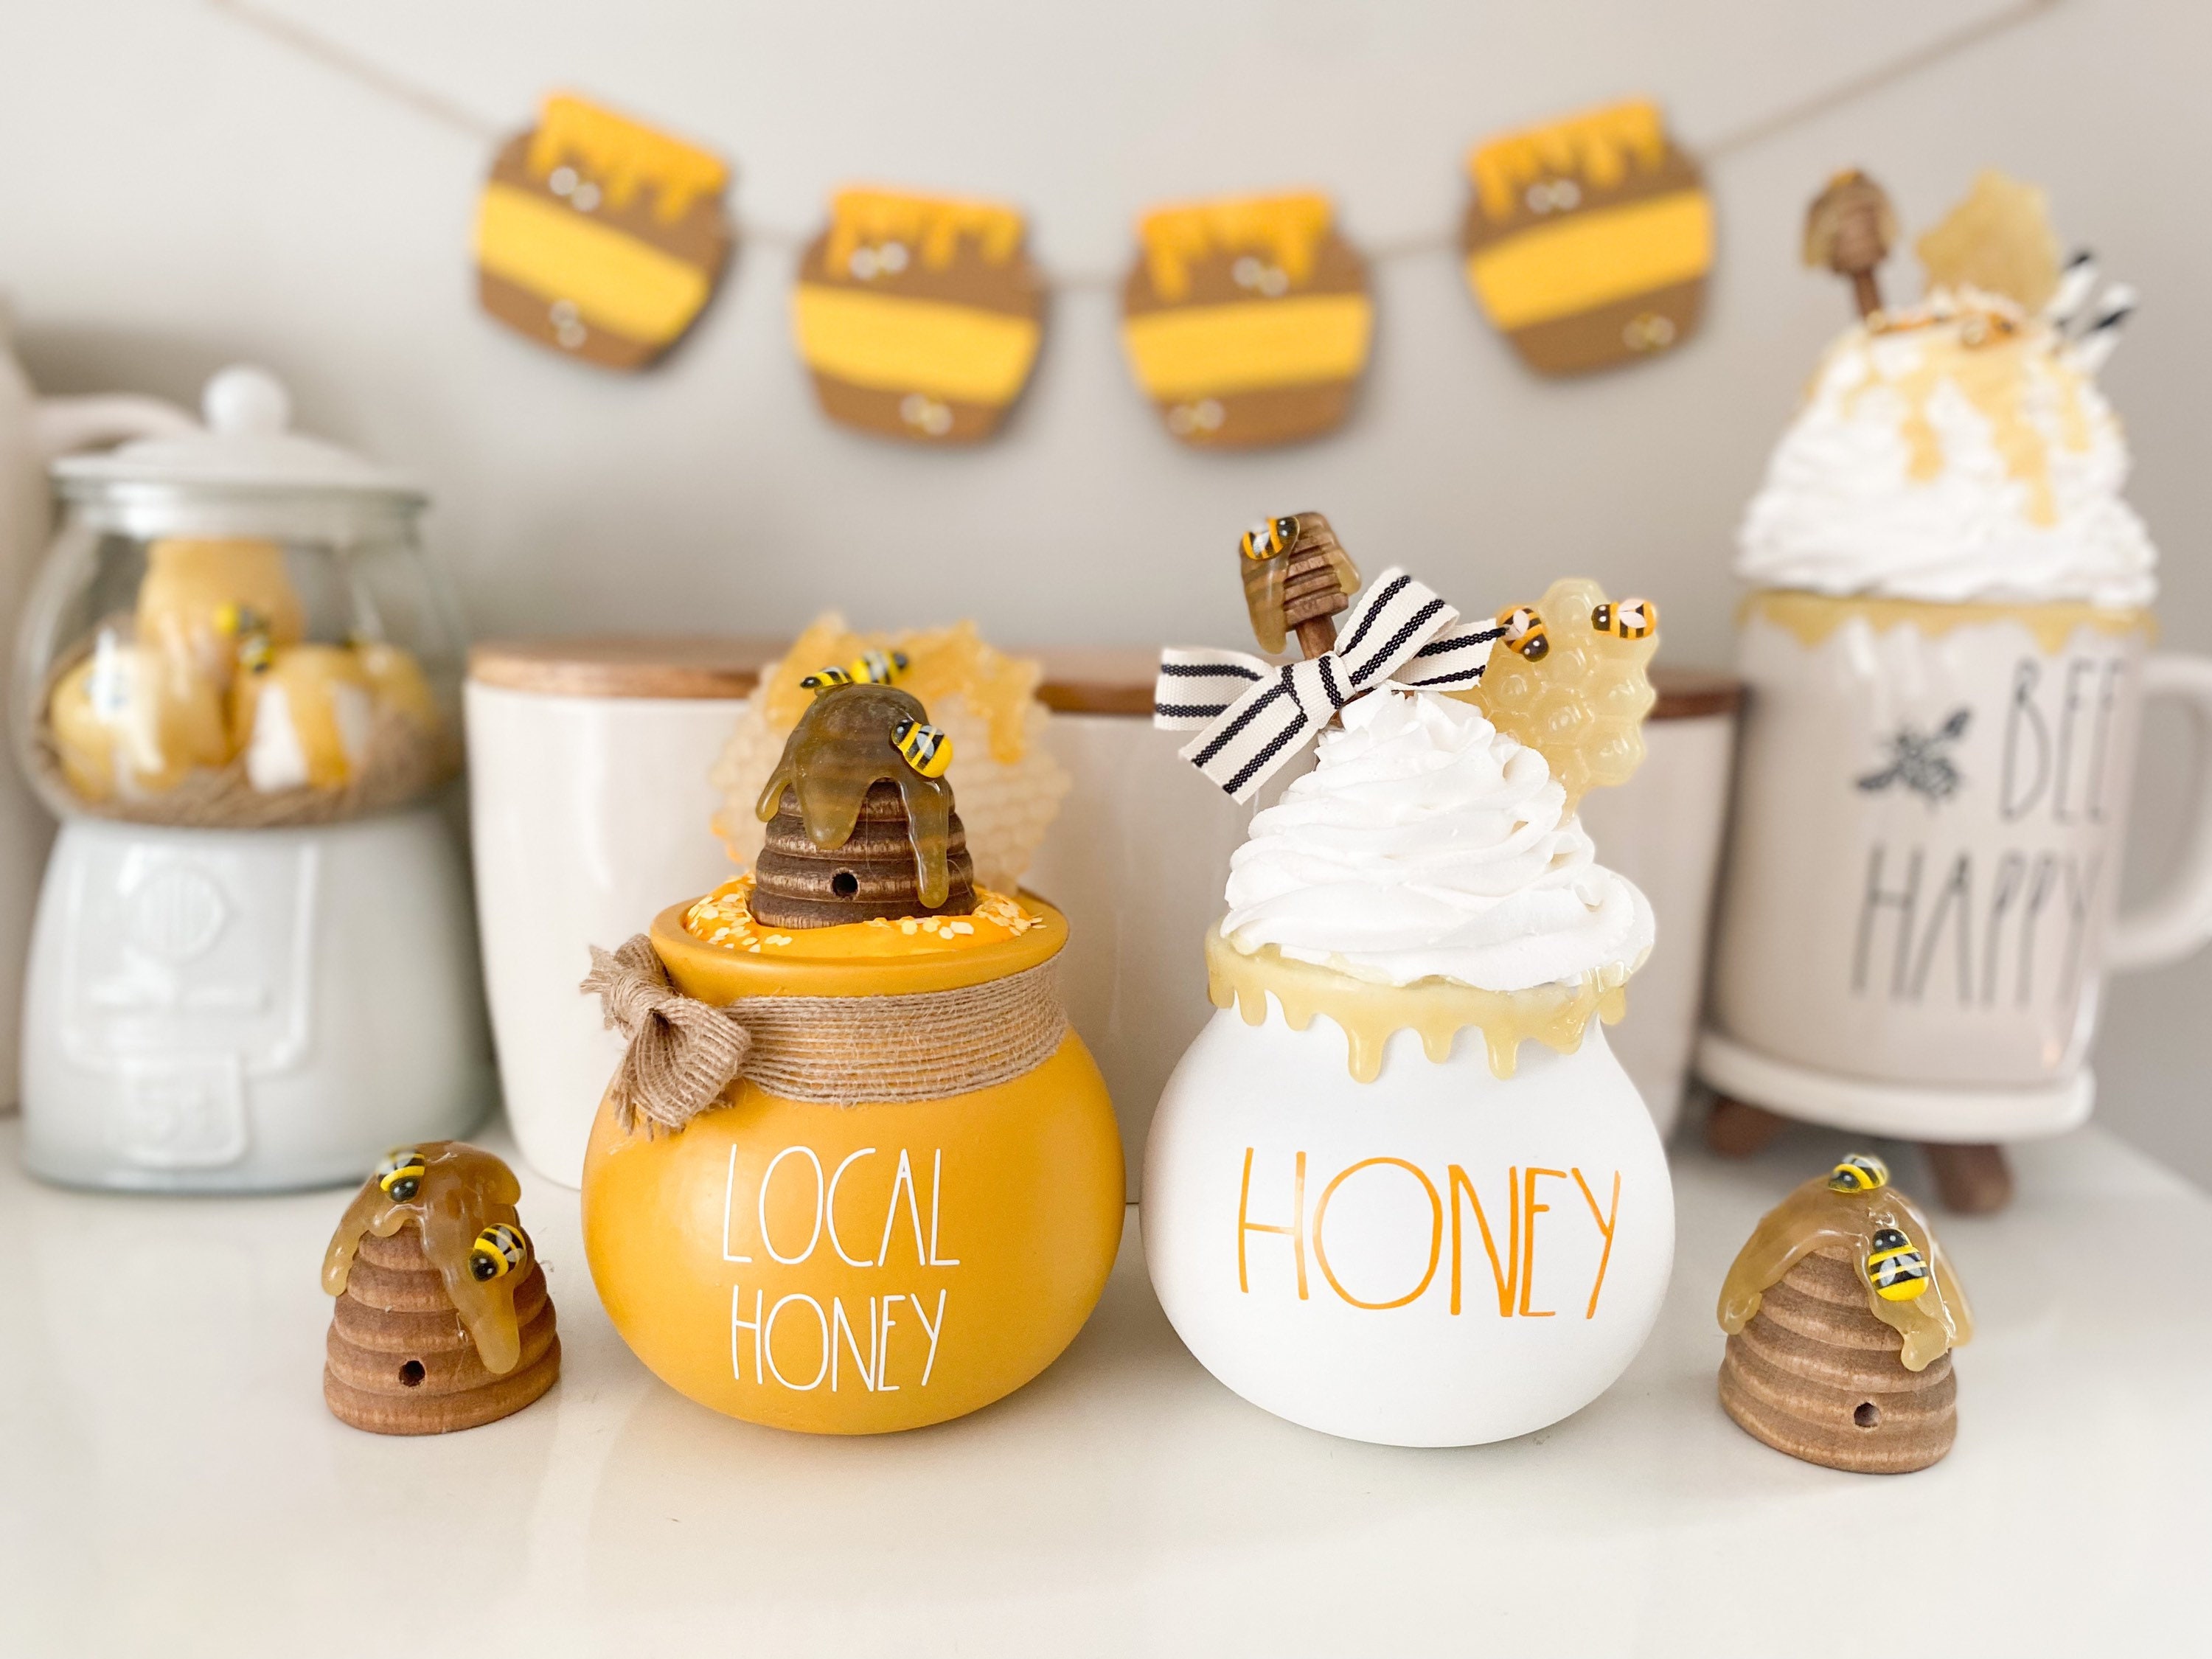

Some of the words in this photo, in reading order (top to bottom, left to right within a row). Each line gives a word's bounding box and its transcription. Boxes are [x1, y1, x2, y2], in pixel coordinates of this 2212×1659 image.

[2001, 658, 2128, 824] BEE
[1851, 844, 2104, 1009] HAPPY
[723, 1143, 961, 1267] LOCAL
[1238, 1147, 1622, 1320] HONEY
[731, 1284, 947, 1393] HONEY
